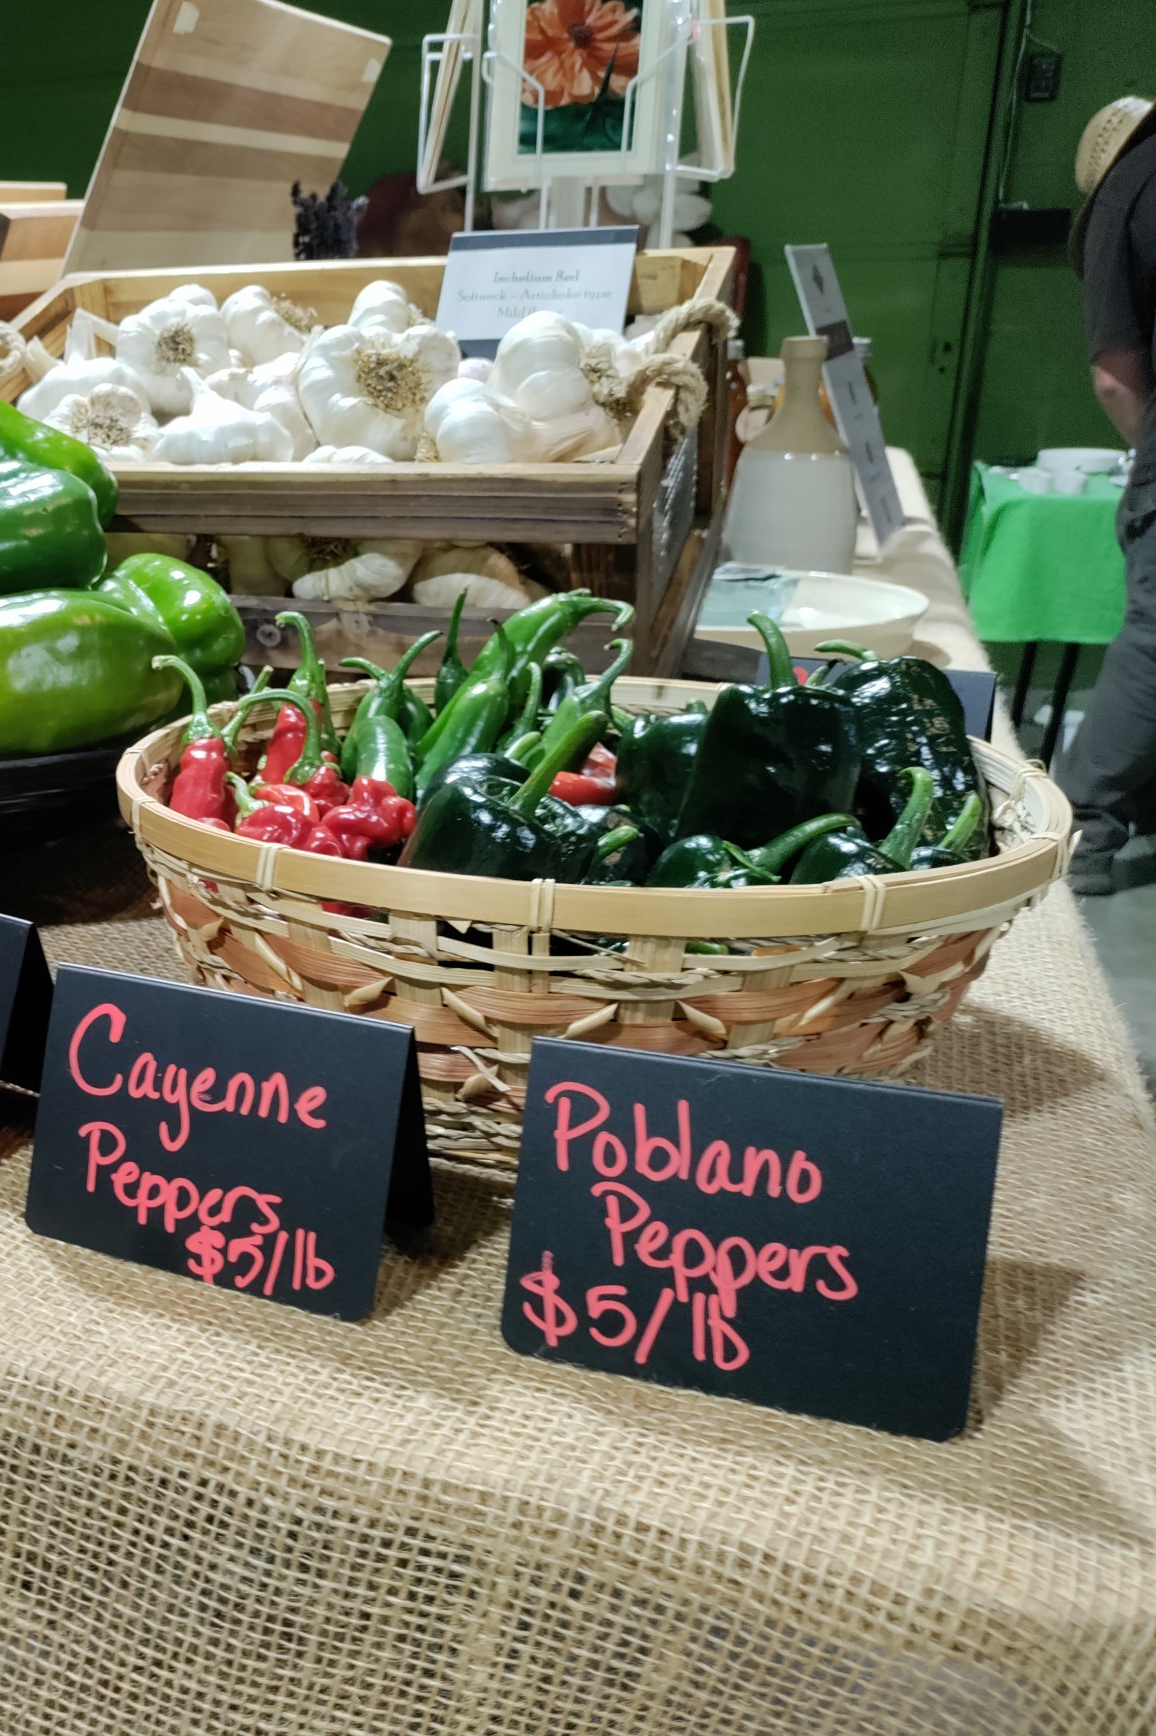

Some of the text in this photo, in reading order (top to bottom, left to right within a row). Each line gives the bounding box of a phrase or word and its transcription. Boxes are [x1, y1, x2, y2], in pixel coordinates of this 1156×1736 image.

[555, 268, 580, 282] Red
[583, 289, 612, 304] type
[68, 1002, 328, 1152] Cayenne
[78, 1120, 283, 1235] Peppers
[544, 1080, 823, 1204] Poblano
[185, 1224, 336, 1296] $5/lb
[590, 1180, 859, 1319] Peppers
